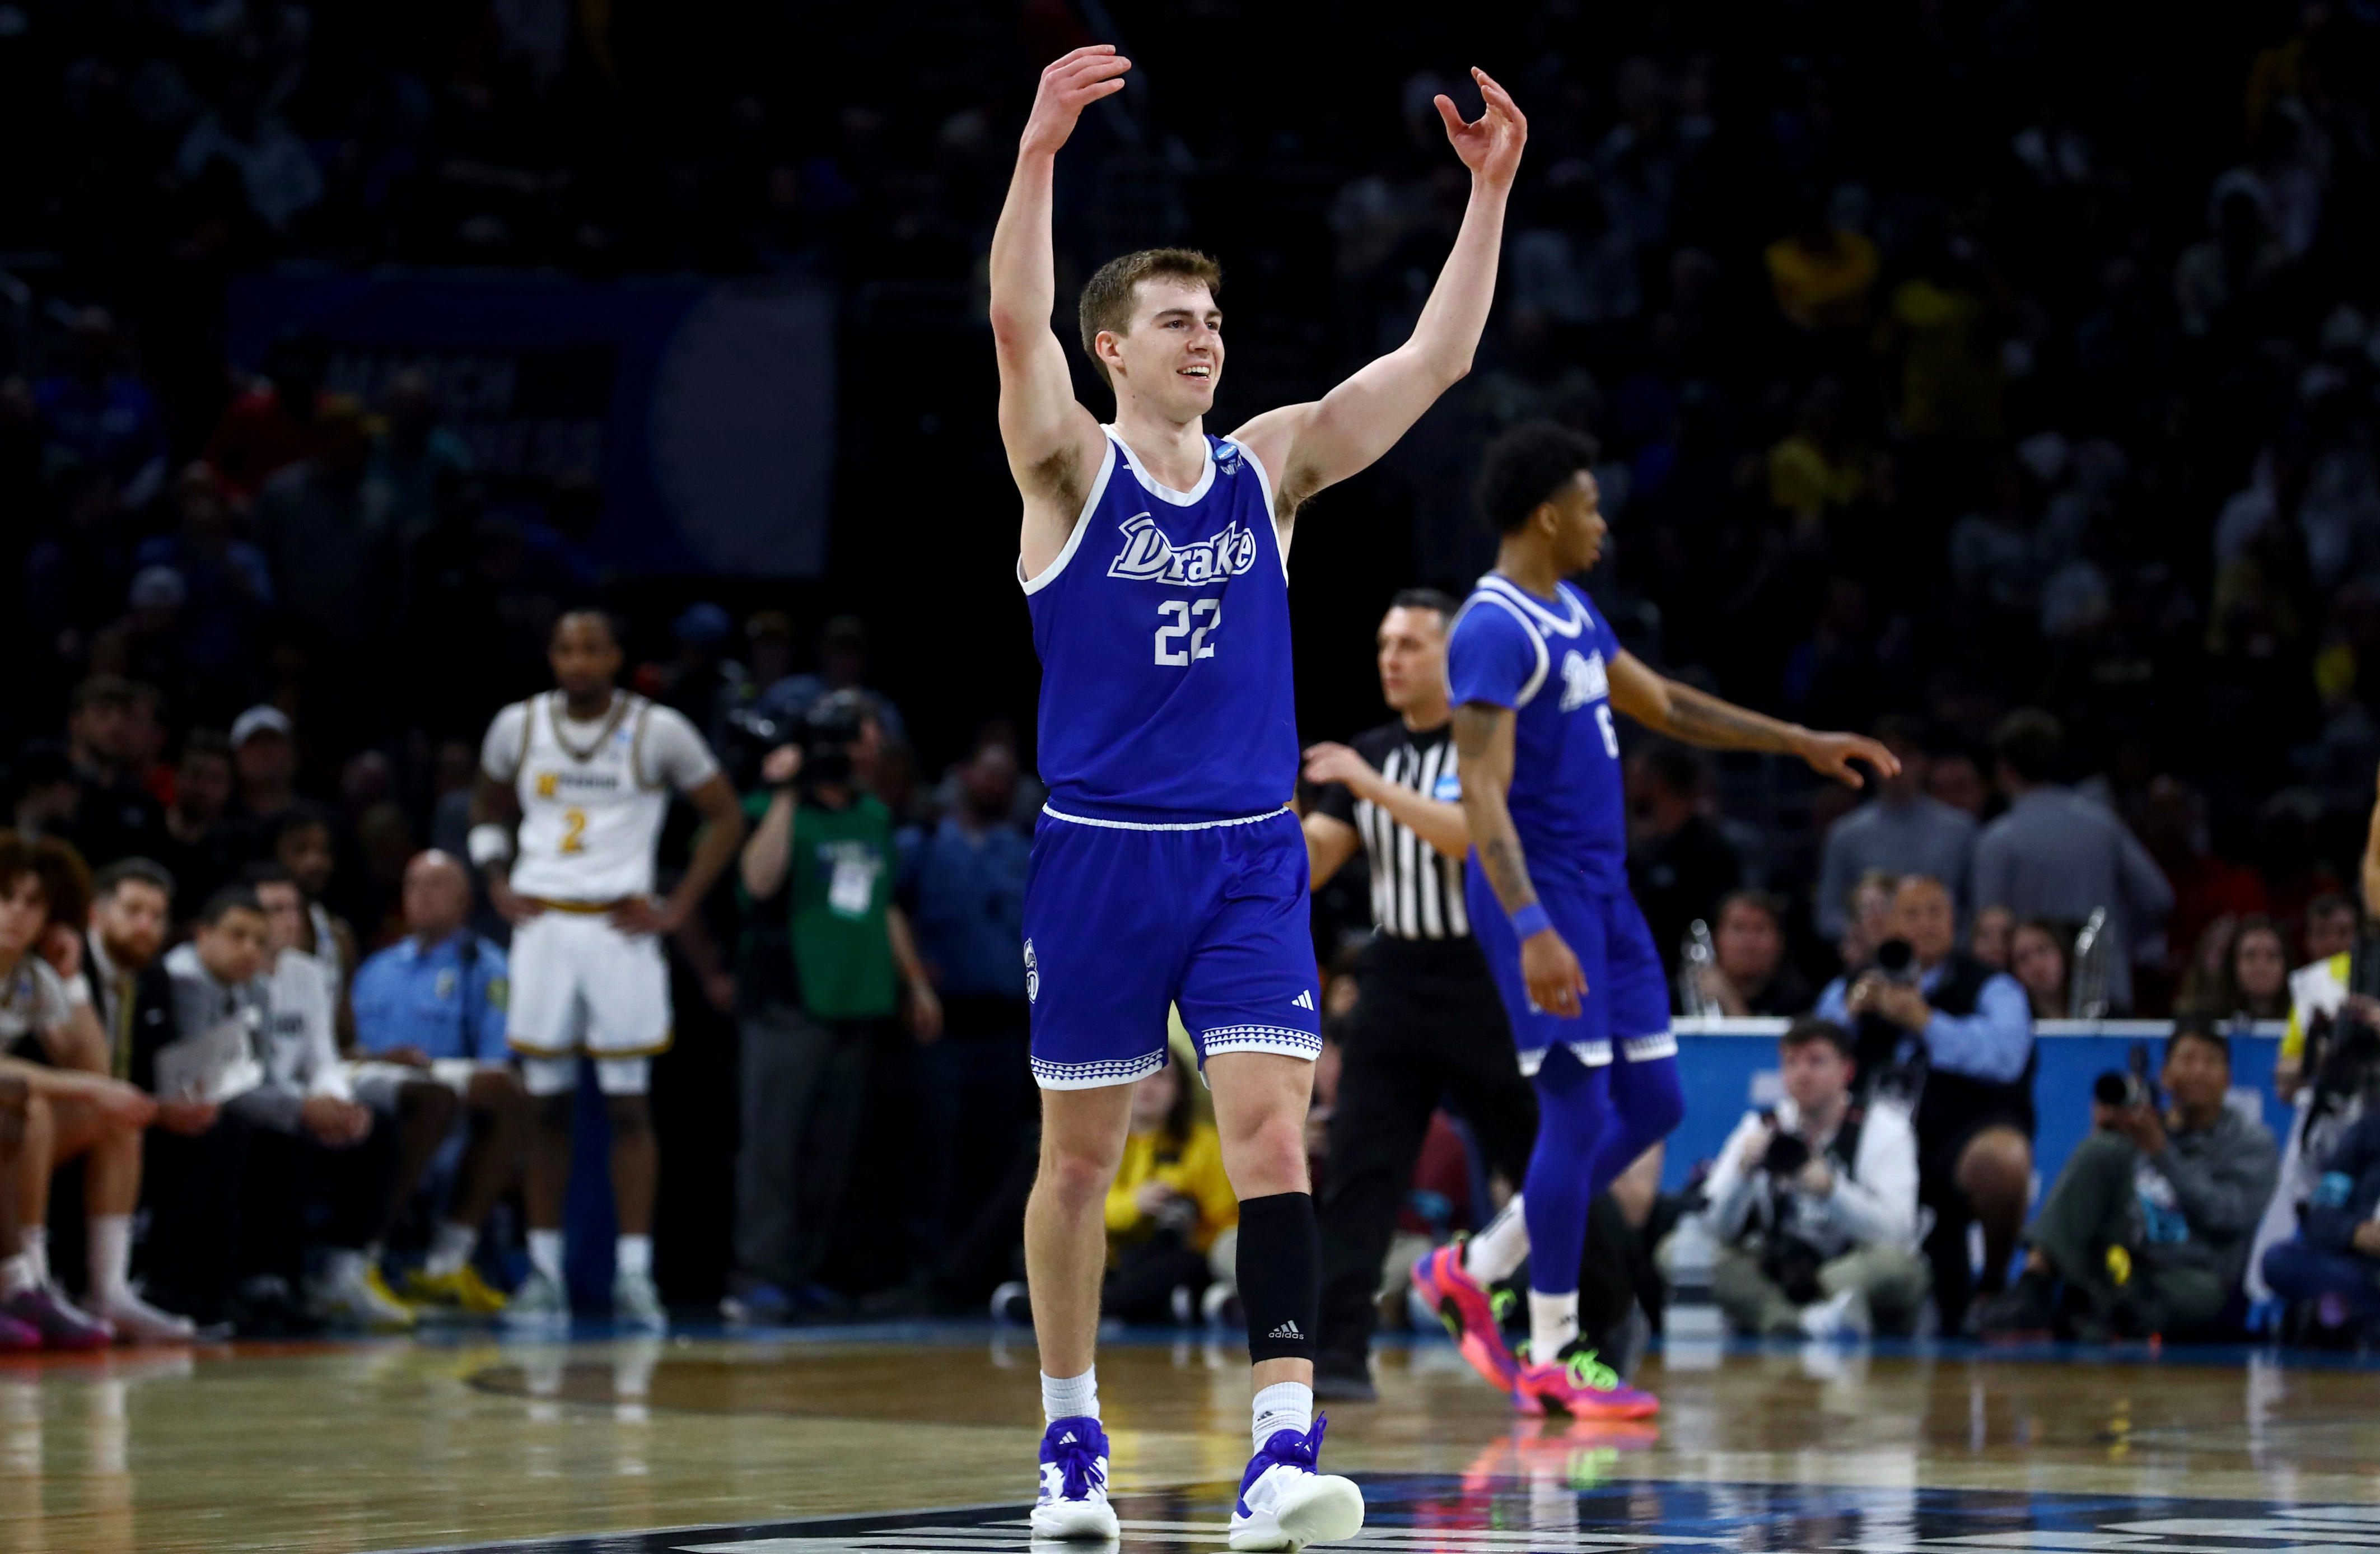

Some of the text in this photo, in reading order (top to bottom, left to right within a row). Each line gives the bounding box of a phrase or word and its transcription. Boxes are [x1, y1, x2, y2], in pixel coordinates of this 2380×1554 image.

[1107, 512, 1257, 586] Drake
[1155, 599, 1221, 666] 22
[561, 808, 585, 853] 2
[1268, 1331, 1304, 1340] adidas
